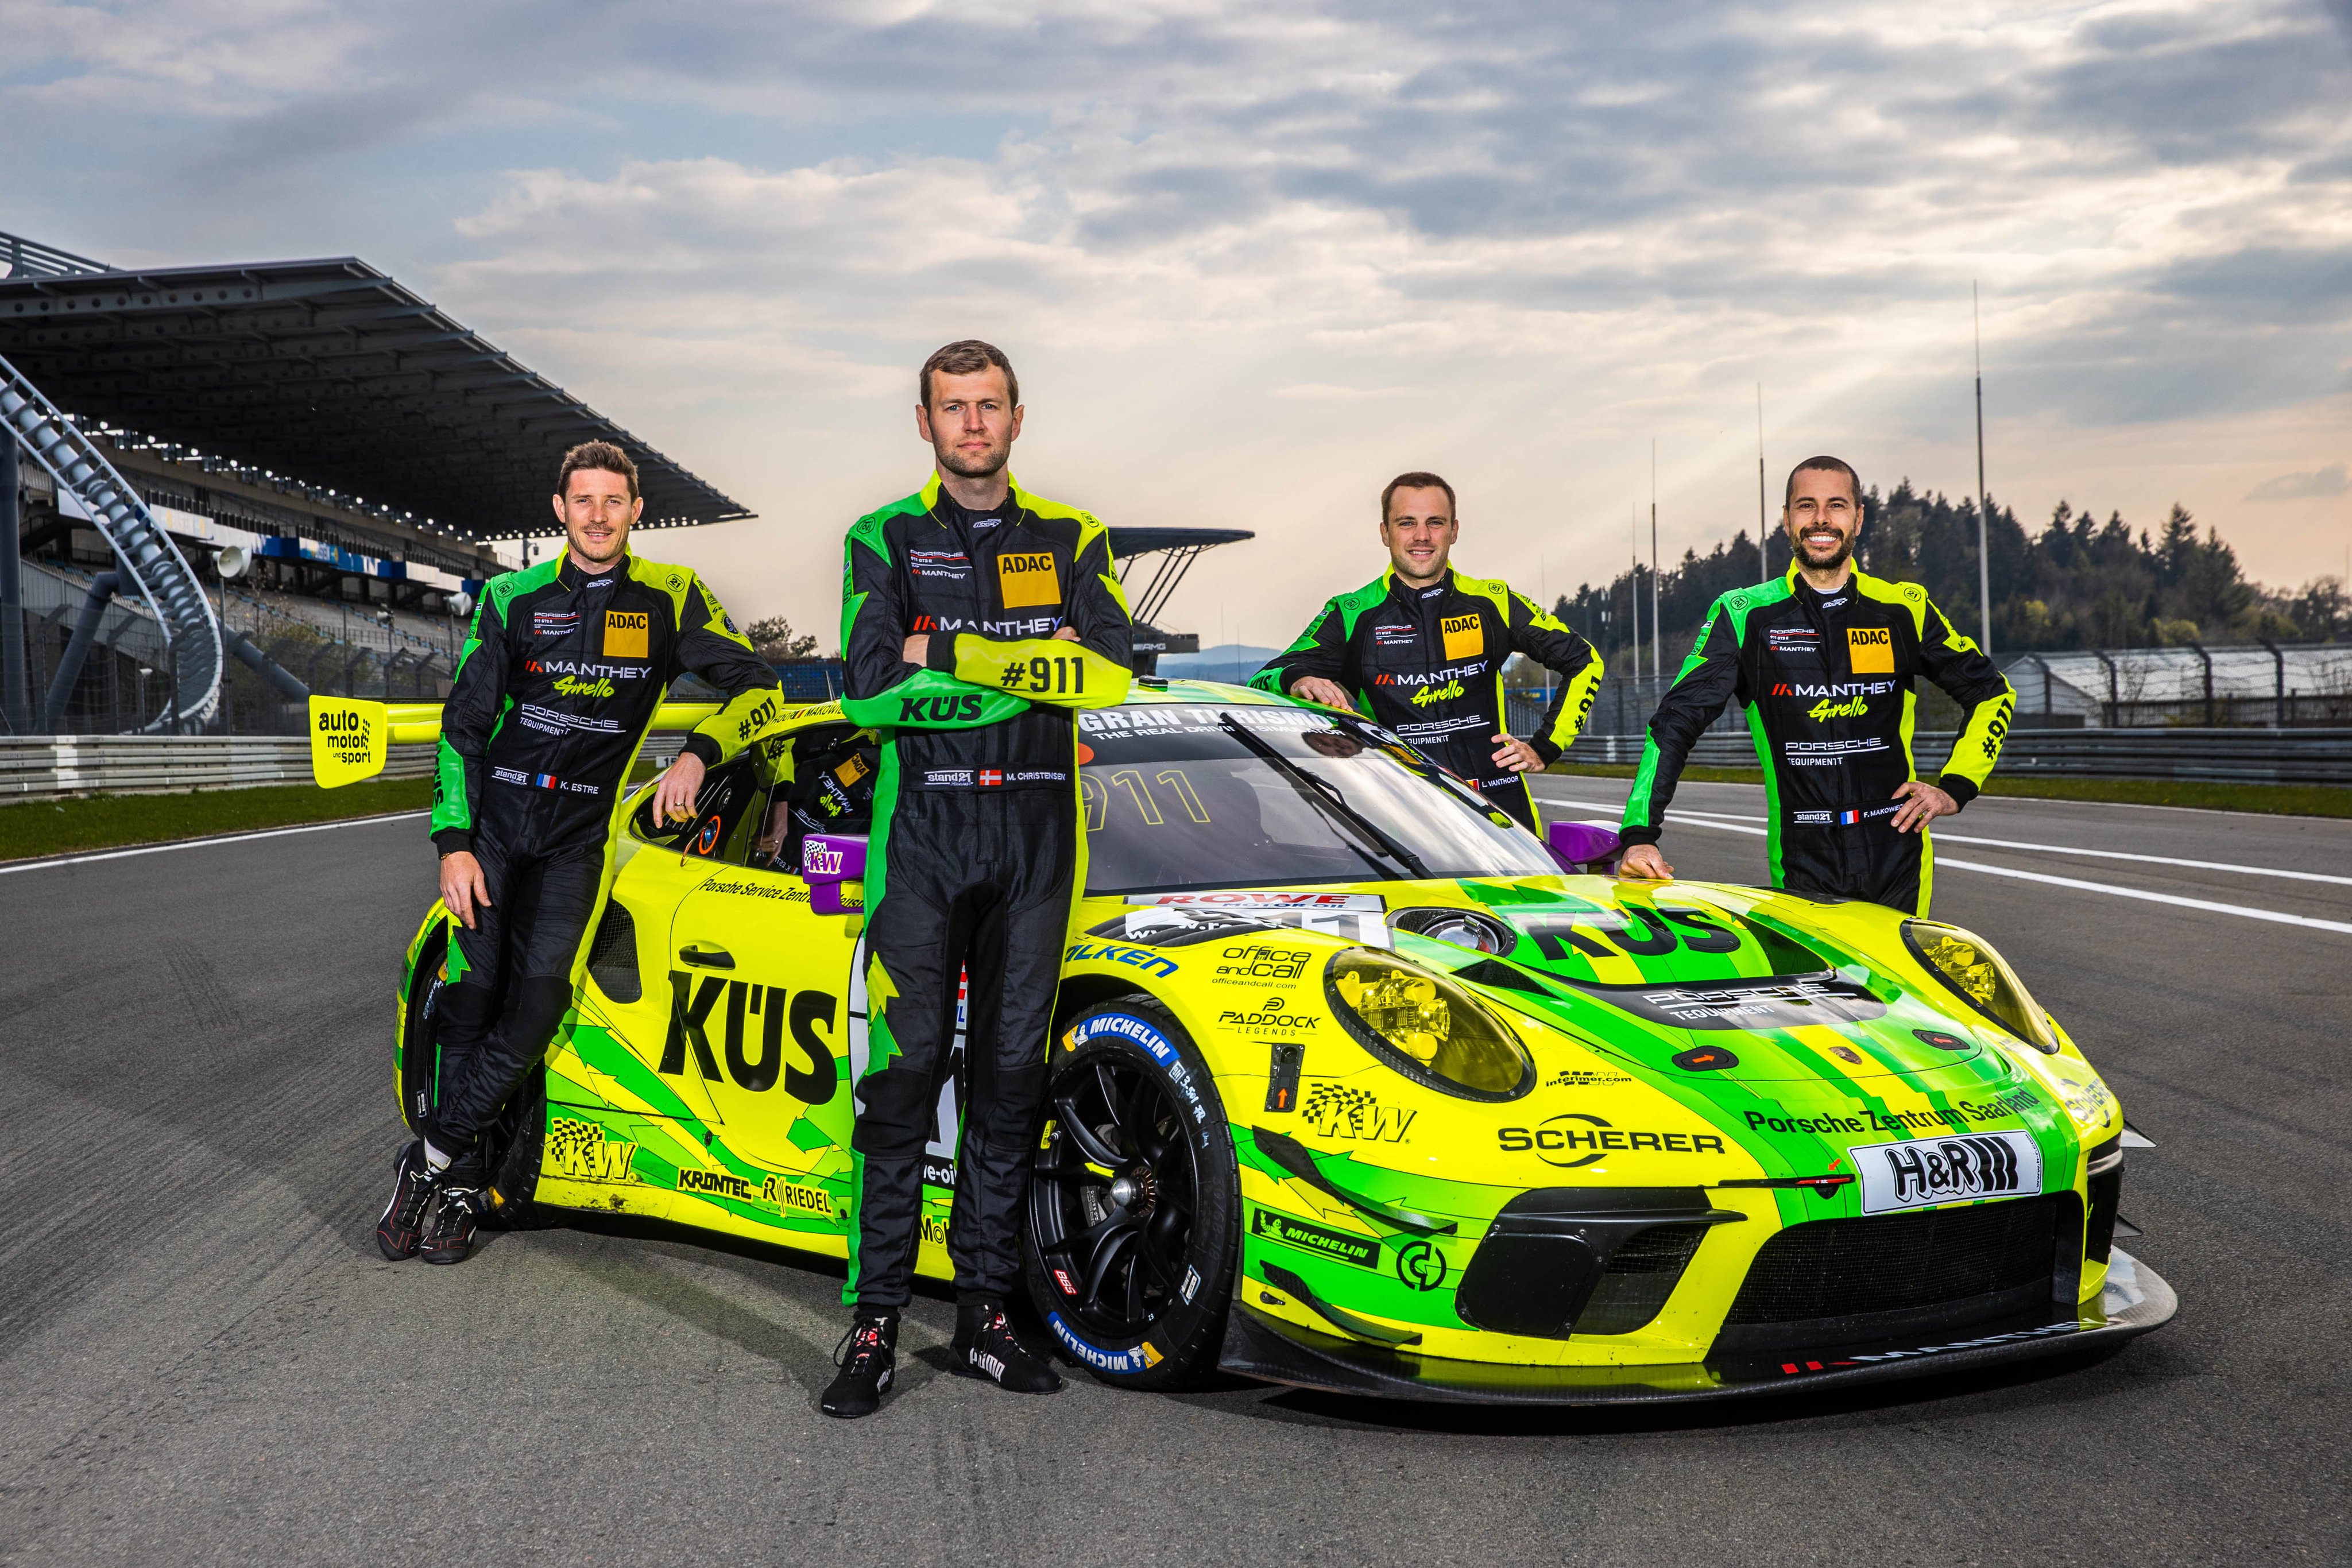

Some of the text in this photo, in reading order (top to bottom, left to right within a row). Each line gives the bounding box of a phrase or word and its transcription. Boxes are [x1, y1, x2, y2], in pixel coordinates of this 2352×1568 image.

[910, 549, 964, 558] PORSCHE
[1002, 555, 1052, 574] ADAC
[670, 578, 681, 589] 21
[922, 570, 965, 579] MANTHEY
[499, 584, 510, 595] 21
[1907, 591, 1918, 599] 21
[1735, 598, 1744, 607] 21
[608, 614, 647, 629] ADAC
[1444, 616, 1479, 634] ADAC
[1851, 630, 1888, 645] ADAC
[546, 661, 652, 679] MANTHEY
[1001, 657, 1084, 694] #911
[1398, 660, 1488, 686] MANTHEY
[1796, 680, 1895, 697] MANTHEY
[900, 694, 982, 722] KÜS
[1575, 675, 1601, 731] #911
[319, 710, 359, 731] auto
[522, 703, 618, 729] PORSCHE
[738, 696, 776, 742] #911
[1078, 710, 1182, 732] GRAN
[1184, 708, 1333, 730] TURISMO
[1396, 715, 1481, 732] PORSCHE
[1092, 731, 1133, 740] THE
[1134, 727, 1183, 736] REAL
[1982, 698, 2013, 761] #911
[328, 734, 366, 748] motor
[1786, 738, 1881, 750] PORSCHE
[342, 751, 370, 765] sport
[928, 772, 971, 784] stand21
[1018, 772, 1066, 781] CHRISTENSEN
[1488, 776, 1519, 787] VANTHOOR
[560, 781, 599, 794] K. ESTRE
[1080, 769, 1211, 832] 911
[810, 852, 842, 873] KW
[699, 878, 742, 895] Porsche
[740, 882, 782, 899] Service
[1156, 894, 1349, 905] ROWE
[1223, 946, 1312, 962] office
[1212, 978, 1296, 989] officeandcall.com
[1642, 984, 1830, 1005] PORSCHE
[1218, 1011, 1321, 1028] PADDOCK
[1669, 1005, 1776, 1021] TEQUIPMENT
[658, 970, 837, 1105] KÜS
[1090, 1016, 1170, 1059] MICHELIN
[1237, 1026, 1296, 1036] LEGENDS
[1546, 1074, 1632, 1087] interimer.com
[1743, 1086, 2040, 1133] Porsche Zentrum Saarland
[1318, 1102, 1418, 1144] KW
[1498, 1127, 1726, 1154] SCHERER
[564, 1141, 635, 1178] KW
[679, 1169, 751, 1199] KRONTEC
[786, 1185, 832, 1214] RIEDEL
[1286, 1227, 1368, 1259] MICHELIN
[1056, 1271, 1076, 1294] BBS
[1053, 1320, 1128, 1370] MICHELIN
[1850, 1317, 2108, 1361] MANTHEY
[969, 1347, 1005, 1383] PUMA
